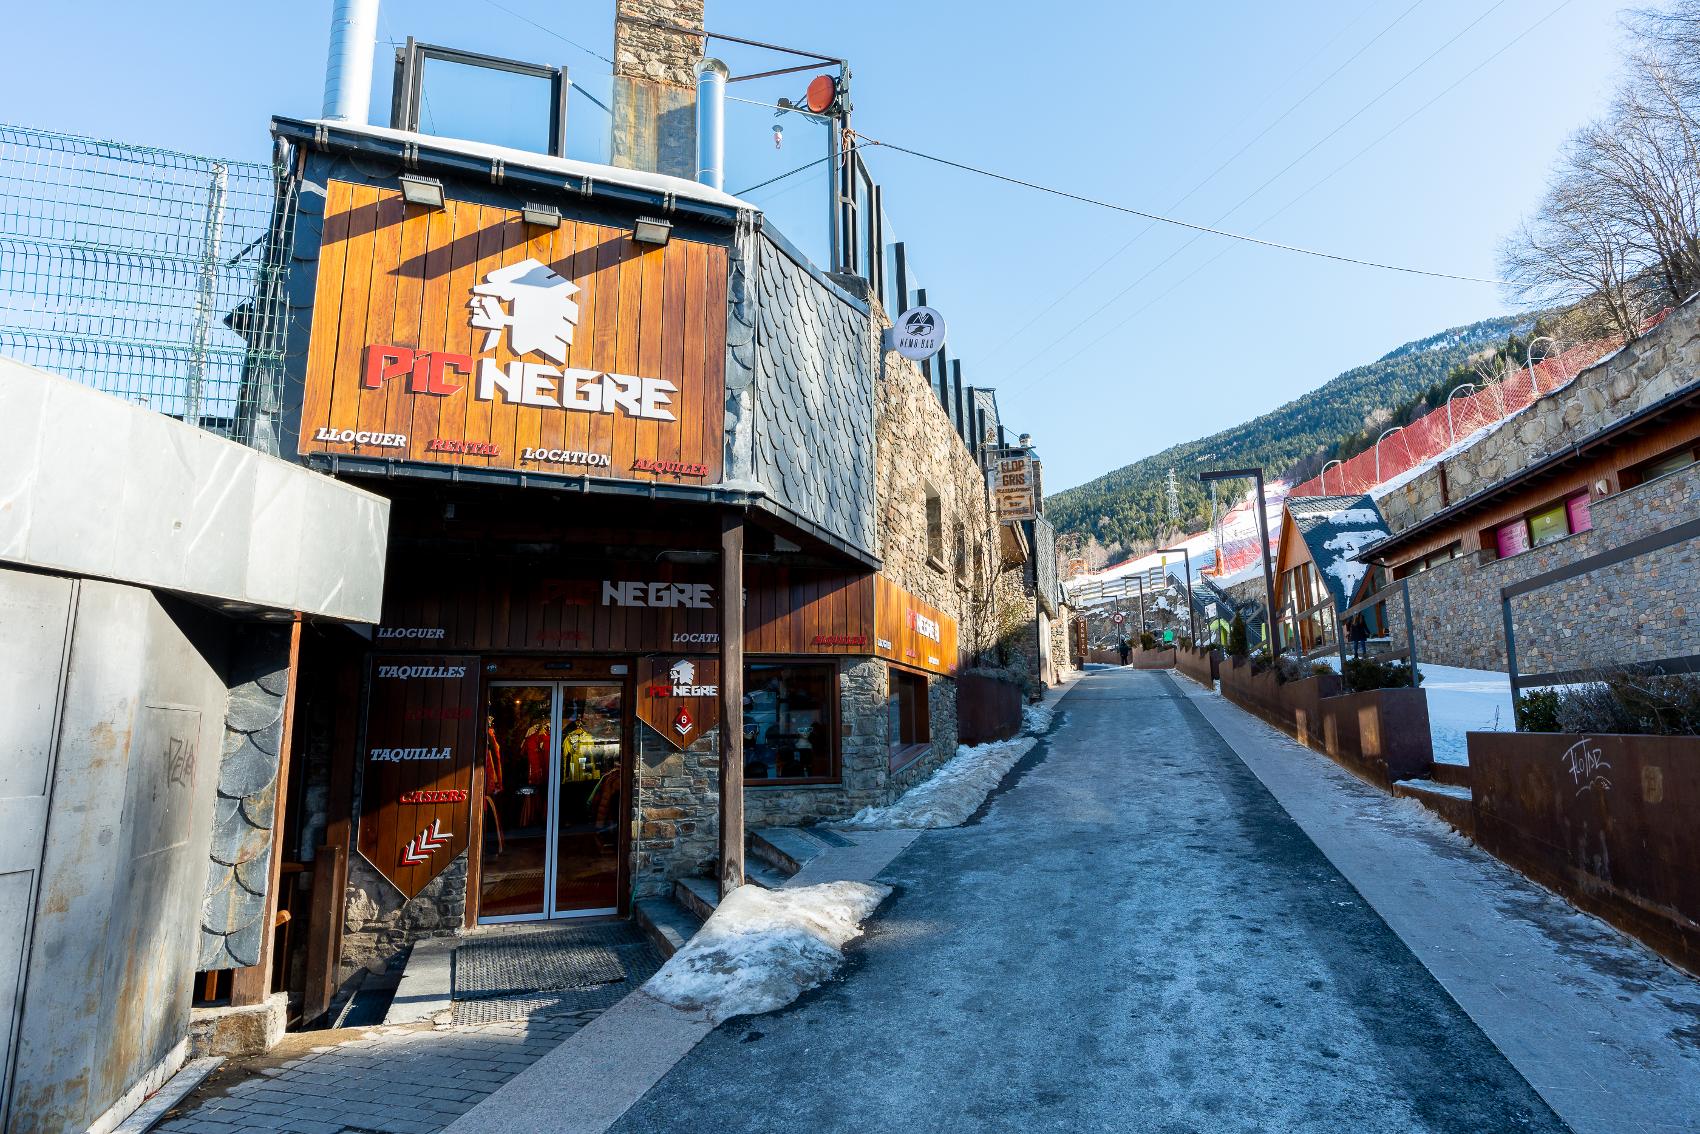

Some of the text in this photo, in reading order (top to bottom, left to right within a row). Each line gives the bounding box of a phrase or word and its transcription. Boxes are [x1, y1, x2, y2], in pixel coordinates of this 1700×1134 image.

[479, 357, 679, 421] NEGRE
[316, 427, 709, 477] LLOGUER RENTAL LOCATION ALQUILER
[1002, 473, 1025, 486] GRIS
[601, 580, 715, 609] NEGRE
[376, 627, 447, 640] LLOGUER
[377, 665, 467, 680] TAQUILLES
[672, 685, 719, 697] NEGRE
[681, 715, 687, 724] 6
[370, 747, 452, 763] TAQUILLA
[399, 789, 469, 804] CASIERS
